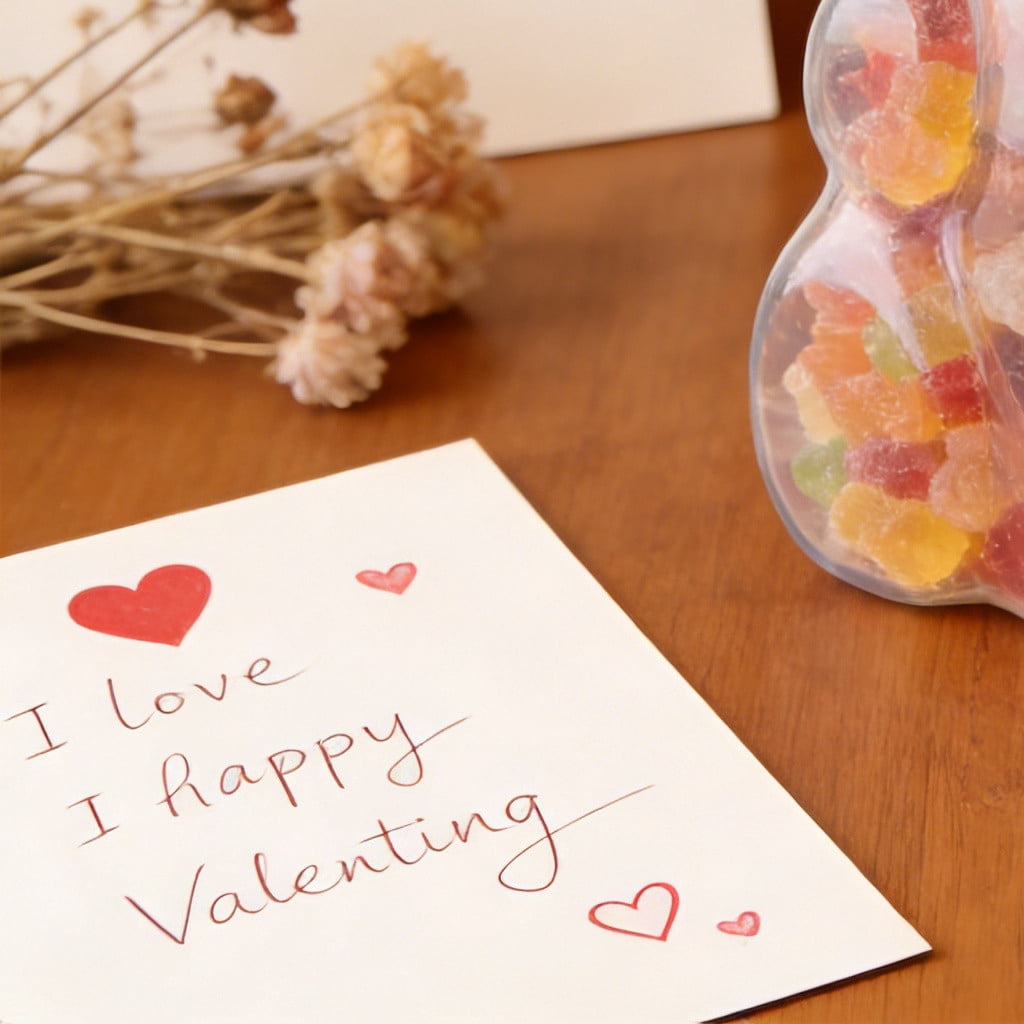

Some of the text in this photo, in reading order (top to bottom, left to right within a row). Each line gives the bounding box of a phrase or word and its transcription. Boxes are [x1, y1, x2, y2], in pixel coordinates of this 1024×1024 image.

[4, 657, 307, 760] I love
[67, 713, 472, 848] I happy
[125, 785, 655, 945] Valenting
